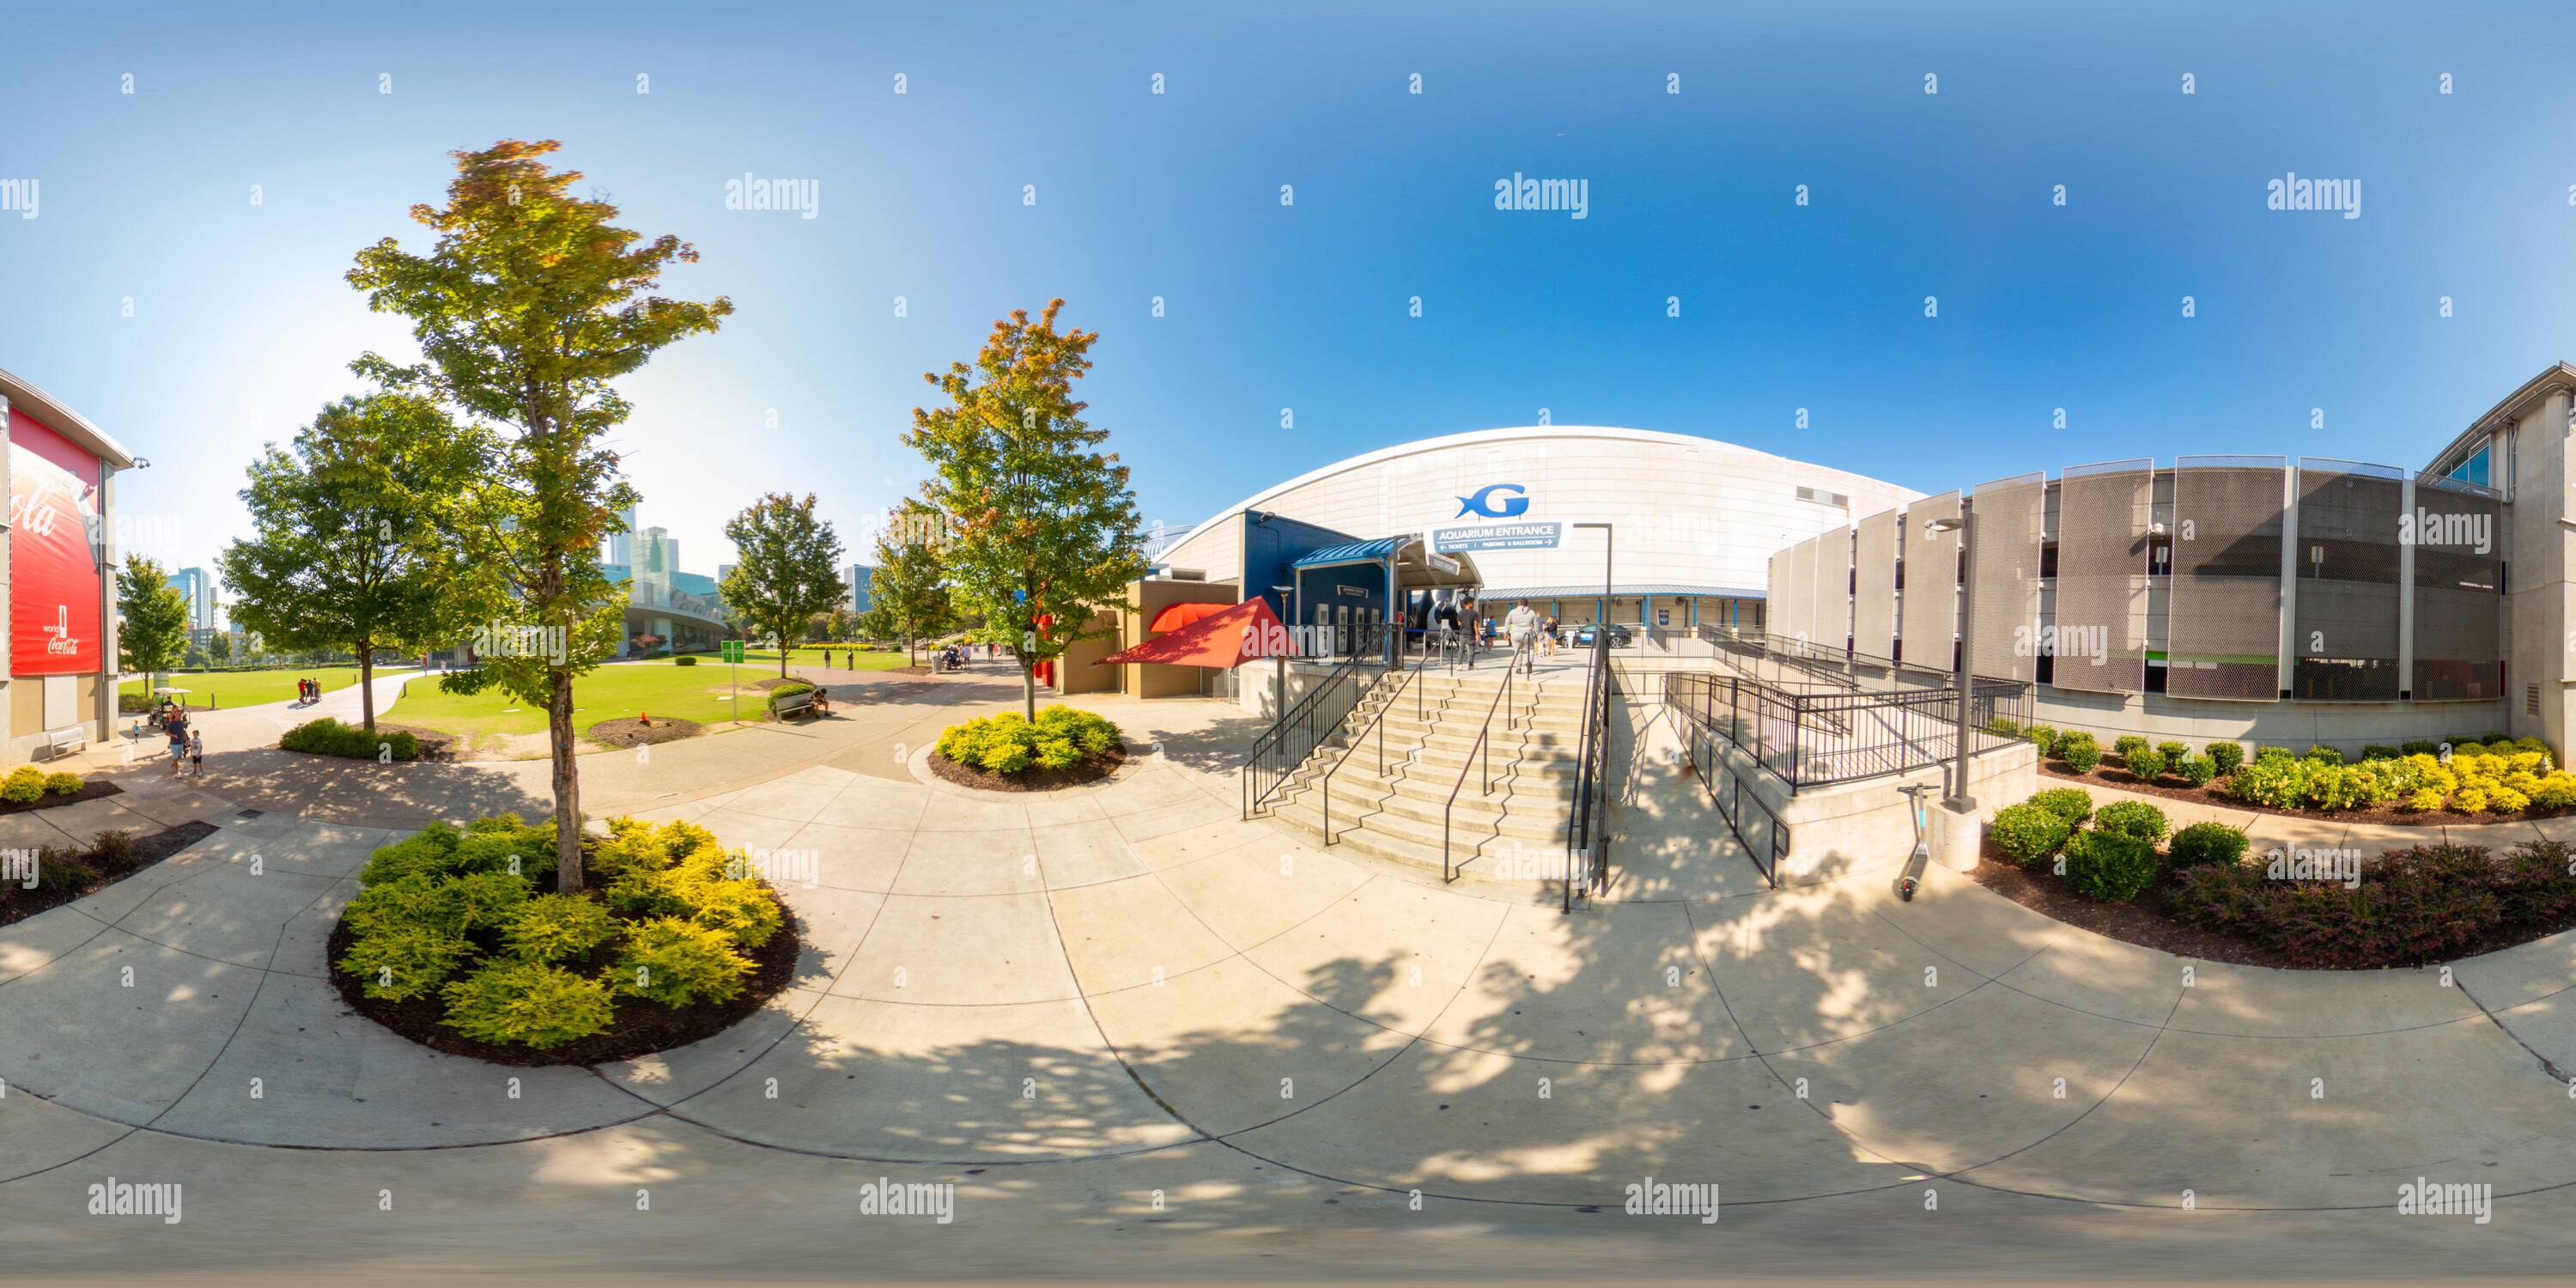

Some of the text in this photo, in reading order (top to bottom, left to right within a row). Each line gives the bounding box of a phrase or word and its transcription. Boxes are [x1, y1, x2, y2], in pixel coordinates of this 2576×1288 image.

[1439, 526, 1553, 541] AQUARIUM ENTRANCE
[43, 624, 59, 633] world
